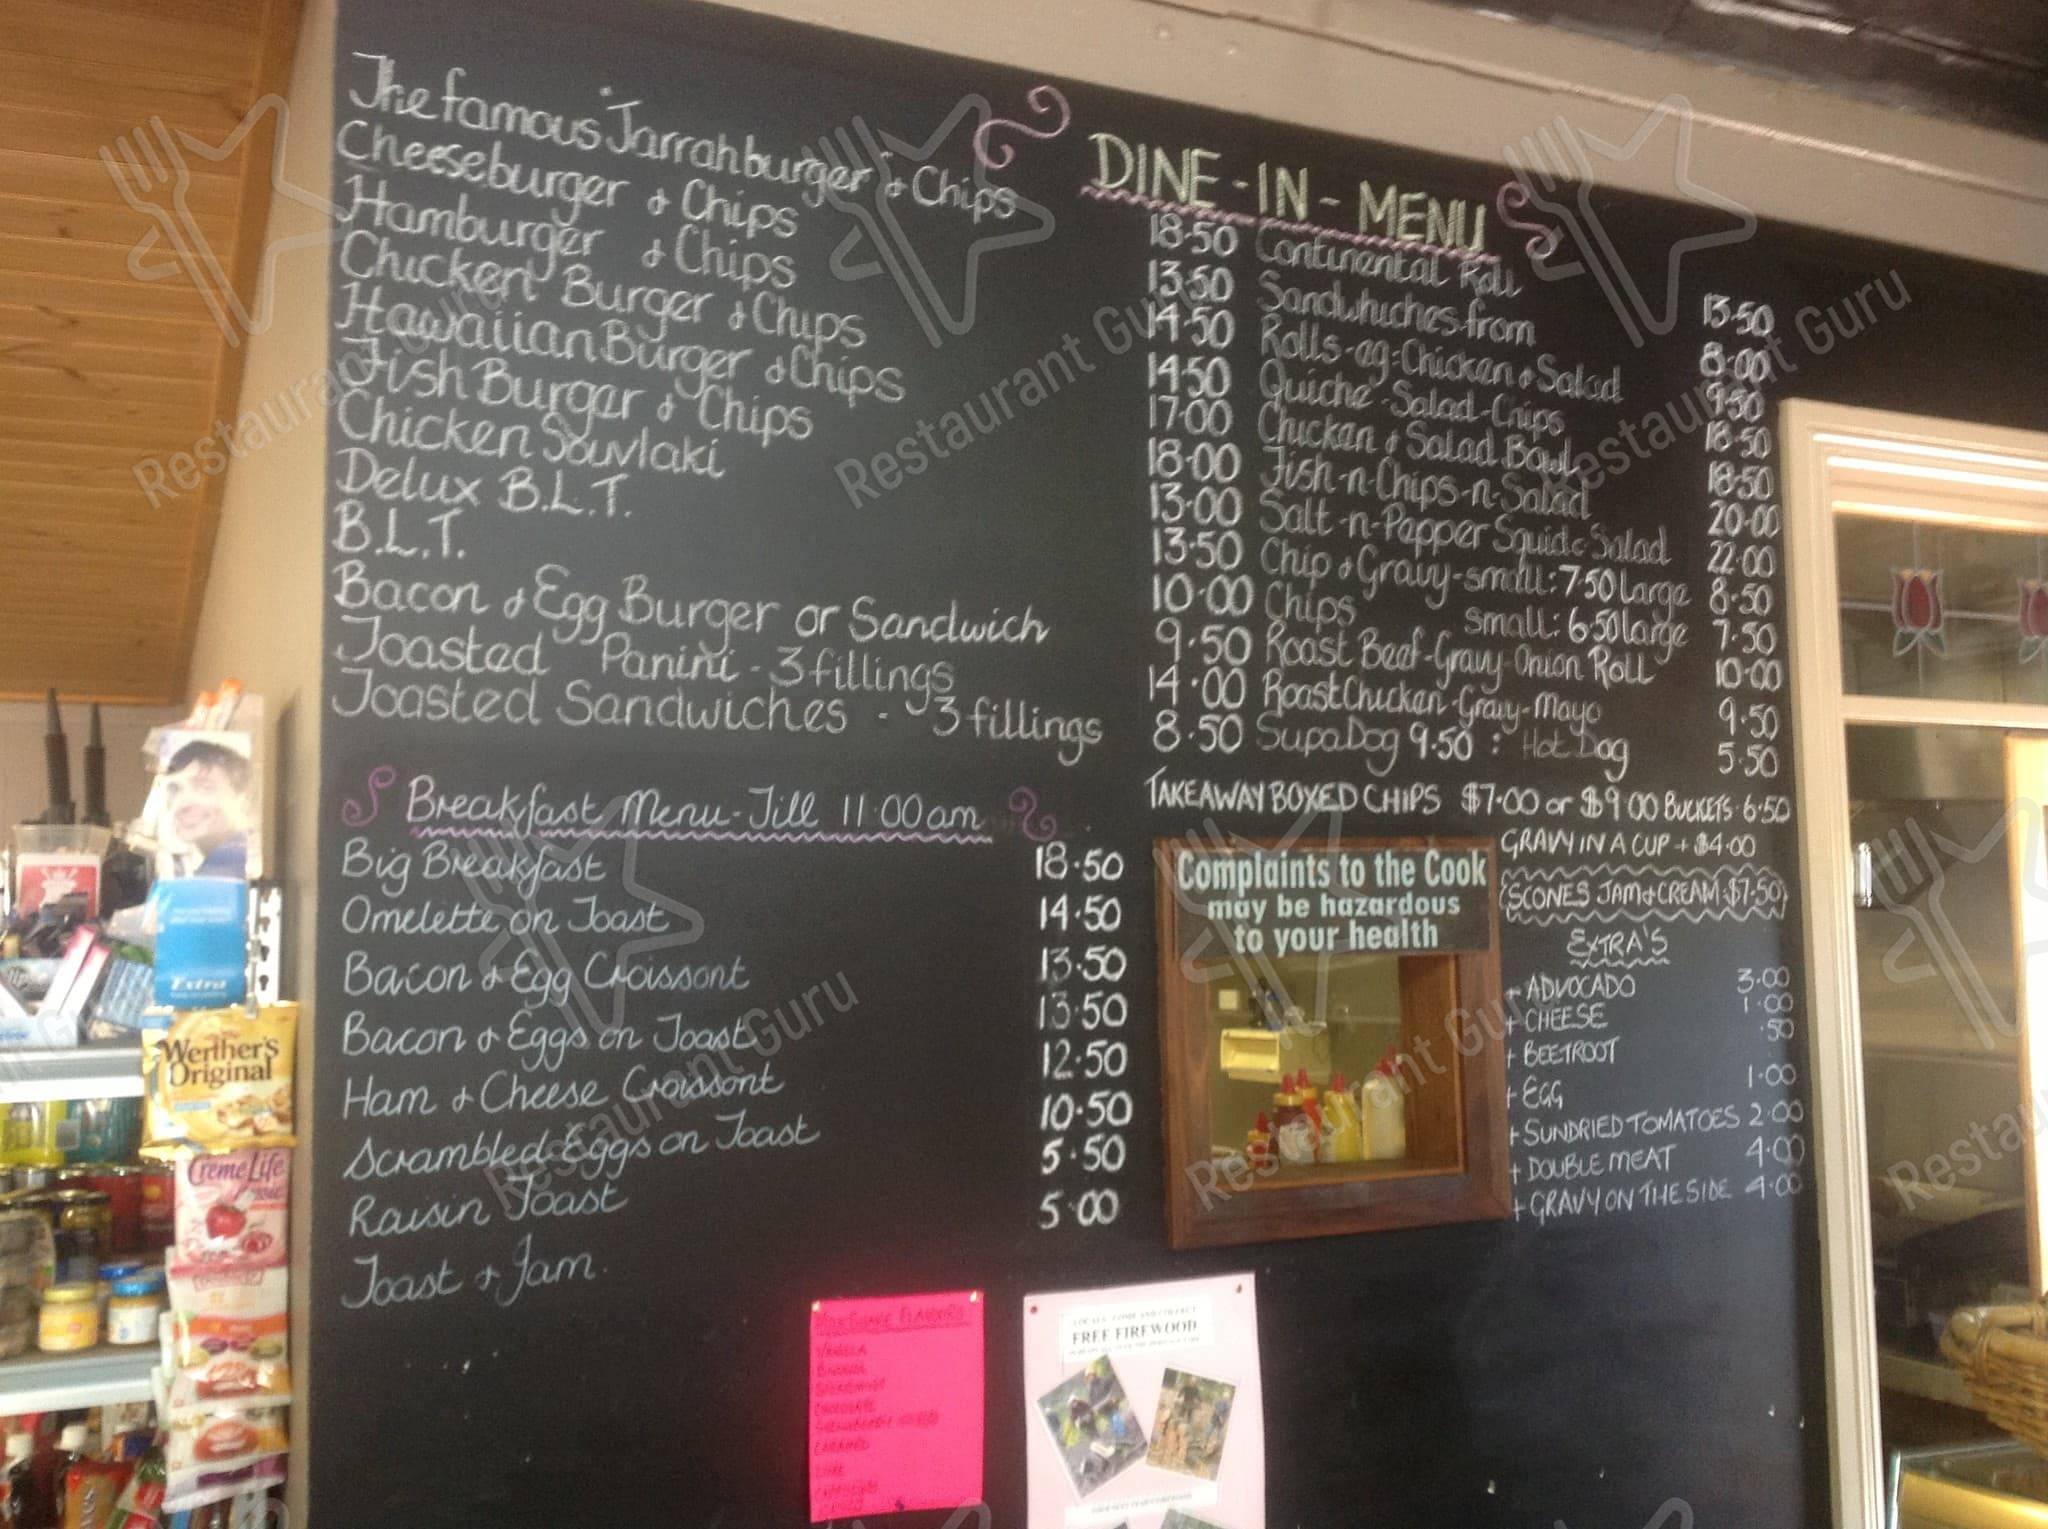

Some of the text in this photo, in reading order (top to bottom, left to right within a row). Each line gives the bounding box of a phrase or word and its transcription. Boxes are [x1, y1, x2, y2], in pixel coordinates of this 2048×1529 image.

[350, 51, 438, 119] The
[441, 67, 600, 150] famous
[913, 165, 1017, 224] Chips
[337, 120, 799, 239] Cheeseburger Chips
[1089, 132, 1486, 253] DINE MENU
[337, 174, 797, 292] Hamburger Chips
[1150, 213, 1239, 257] 18.50
[341, 230, 867, 352] Chicken Burger Chips
[1149, 259, 1235, 303] 13.50
[335, 281, 905, 408] Hawaiian Burger Chips
[1149, 301, 1235, 351] 14.50
[1148, 351, 1232, 399] 14.50
[338, 388, 534, 458] Chicken
[699, 384, 815, 448] Chips
[1150, 393, 1234, 437] 17.00
[1149, 437, 1243, 483] 18.00
[1406, 420, 1499, 467] Salad
[335, 447, 484, 507] Delux
[1150, 482, 1243, 527] 13.00
[332, 499, 466, 559] B.L.T.
[1153, 526, 1243, 571] 13.50
[333, 559, 1050, 657] Bacon Egg Burger or Sandwich
[1152, 572, 1255, 617] 10.00
[1265, 580, 1358, 634] Chips
[1709, 576, 1774, 616] 8.50
[1155, 617, 1251, 666] 9.50
[1265, 619, 1354, 668] Roast
[335, 615, 552, 676] Toasted
[602, 631, 741, 682] Panini
[809, 646, 955, 716] fillings
[1149, 664, 1247, 710] 14.00
[1715, 656, 1783, 692] 10.00
[332, 667, 543, 726] Toasted
[555, 679, 849, 736] Sandwiches
[966, 694, 1103, 767] fillings
[1153, 709, 1243, 754] 8.50
[1718, 696, 1779, 741] 9.50
[1409, 721, 1473, 760] 9.50
[1717, 741, 1779, 778] 5.50
[406, 775, 602, 840] Breakfast
[1364, 783, 1441, 815] CHIPS
[1545, 795, 1574, 816] or
[1035, 841, 1124, 881] 18.50
[1632, 832, 1671, 857] CUP
[341, 837, 607, 899] Big Breakfast
[1177, 849, 1487, 898] Complaints to the Cook
[341, 893, 671, 935] Omelette on Toast
[1039, 893, 1122, 932] 14.50
[1208, 891, 1461, 925] may be hazardous
[1234, 919, 1438, 958] to your health
[171, 976, 228, 991] Extra
[343, 949, 573, 1010] Bacon Egg
[1041, 946, 1128, 984] 13.50
[1737, 966, 1790, 994] 3.00
[1525, 1001, 1609, 1033] CHEESE
[157, 1036, 280, 1067] Werther's
[342, 1009, 757, 1072] Bacon Eggs on Toast
[1042, 1039, 1128, 1079] 12.50
[1524, 1036, 1620, 1067] BEETROOT
[169, 1056, 273, 1090] Original
[343, 1070, 609, 1120] Ham Cheese
[1522, 1075, 1563, 1110] EGG
[1041, 1090, 1133, 1131] 10.50
[1523, 1100, 1804, 1147] SUNDRIED TOMATOES 2.00
[342, 1109, 821, 1181] Scrambled Eggs on Toast
[1041, 1134, 1126, 1175] 5.50
[1528, 1153, 1604, 1181] DOUBLE
[1609, 1144, 1677, 1172] MEAT
[187, 1151, 285, 1188] Creme Life
[348, 1174, 629, 1237] Raisin Toast
[1039, 1188, 1119, 1229] 5.00
[342, 1255, 463, 1310] Toast
[1115, 1319, 1198, 1341] FIREWOOD
